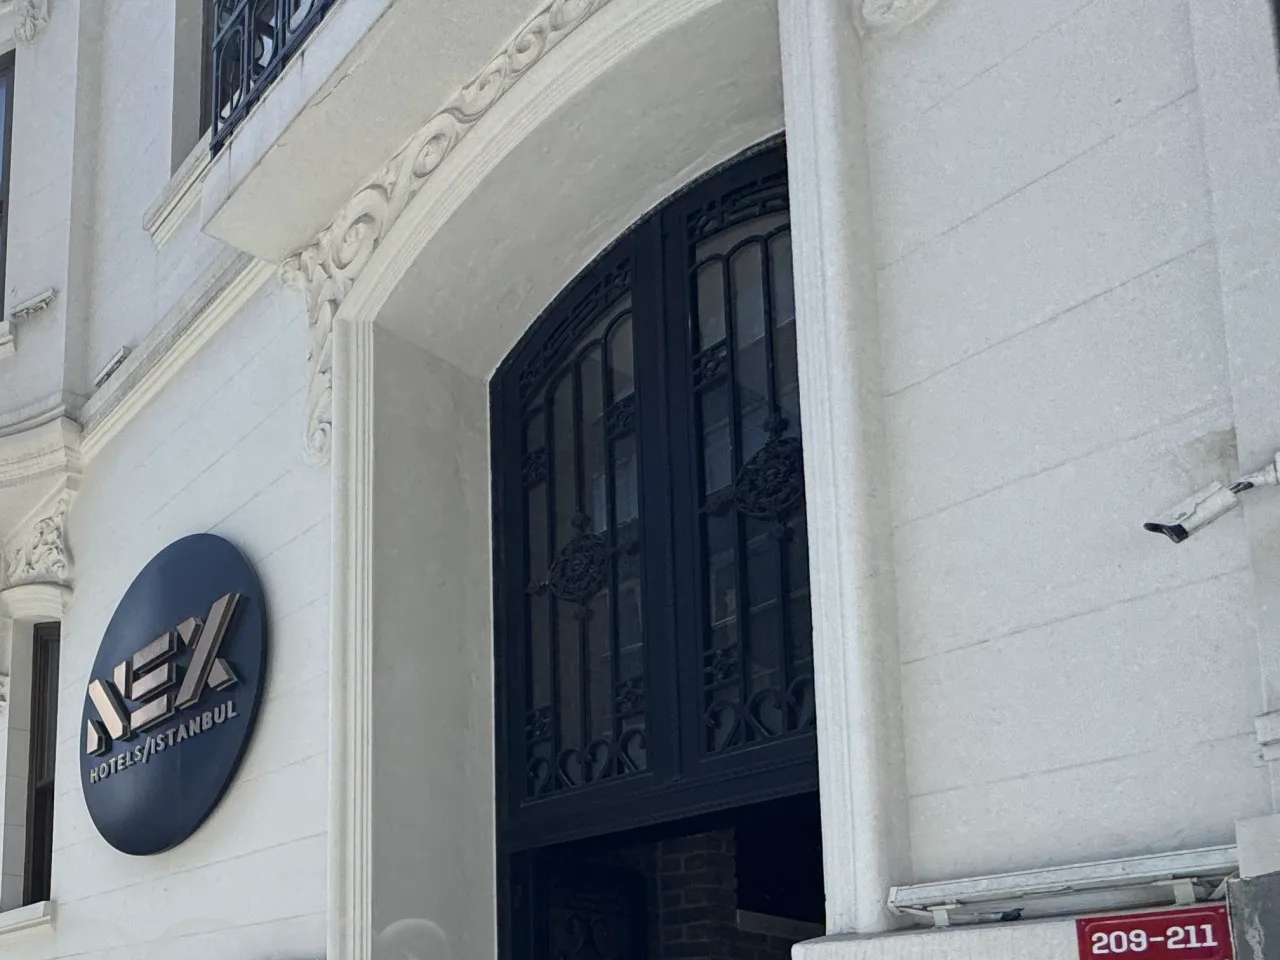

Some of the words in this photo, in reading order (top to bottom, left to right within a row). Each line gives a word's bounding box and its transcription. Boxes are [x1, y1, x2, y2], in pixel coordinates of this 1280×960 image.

[86, 592, 241, 757] NEX
[89, 700, 238, 784] HOTELS/ISTANBUL
[1091, 923, 1218, 955] 209-211
